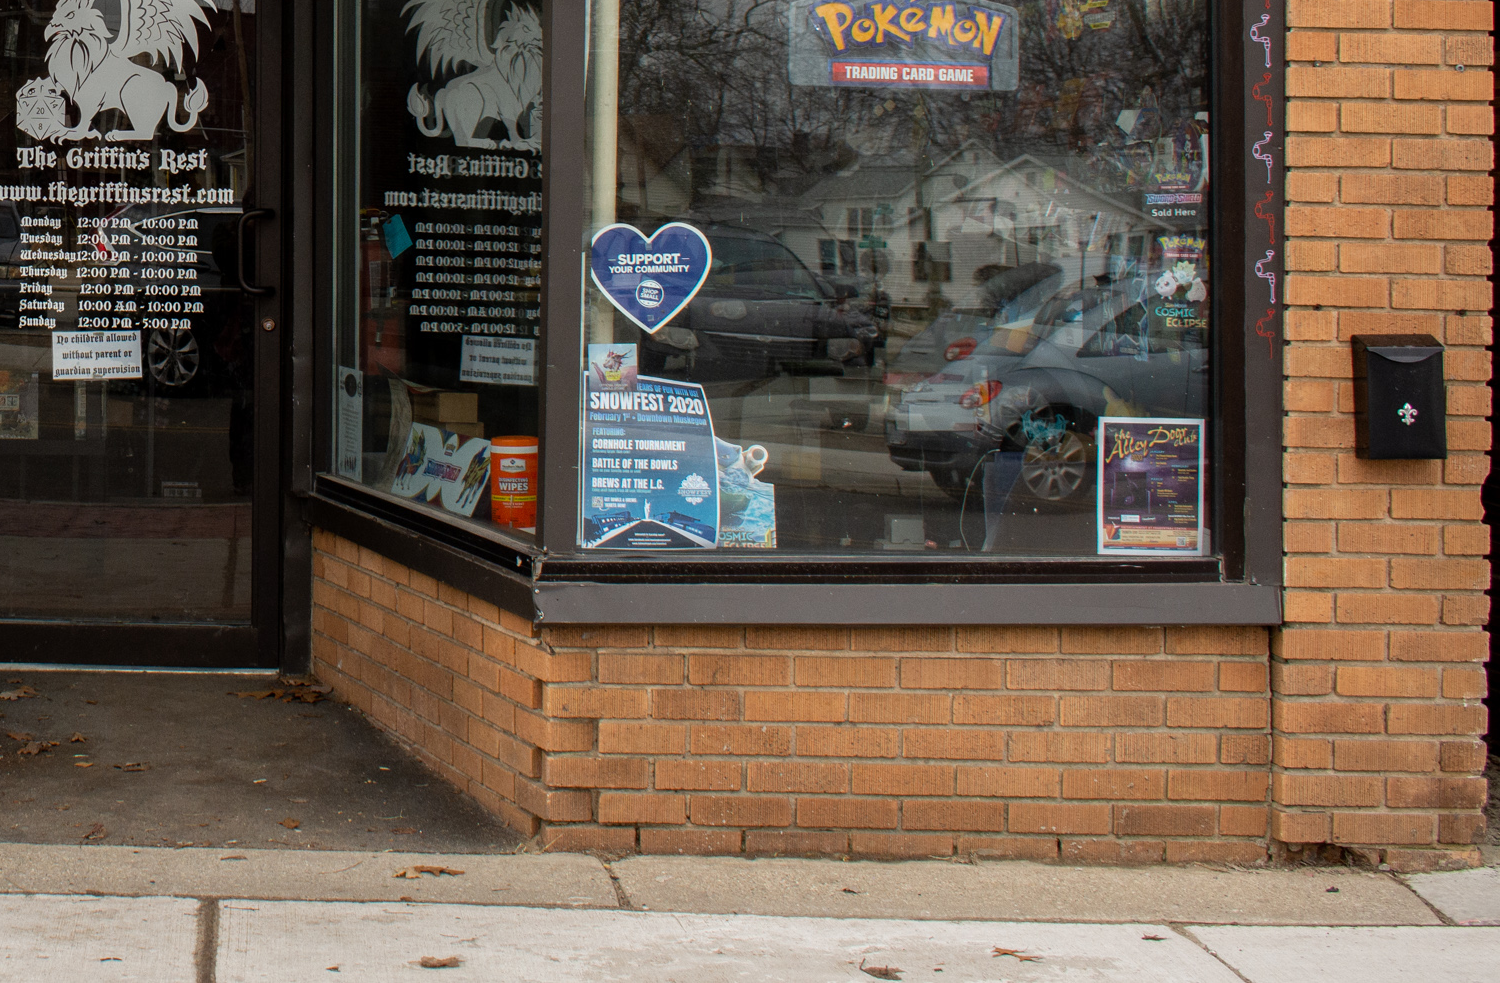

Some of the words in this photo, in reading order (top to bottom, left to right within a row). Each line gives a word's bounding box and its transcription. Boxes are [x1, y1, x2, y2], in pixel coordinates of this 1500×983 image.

[844, 65, 898, 82] TRADING
[901, 65, 936, 82] CARD
[938, 66, 974, 83] GAME
[16, 146, 57, 171] The
[66, 146, 150, 171] Griffin's
[158, 148, 208, 174] Rest
[1151, 208, 1172, 216] Sold
[20, 216, 62, 230] Monday
[77, 217, 108, 229] 12:00
[110, 218, 131, 230] PM
[142, 218, 175, 230] 10:00
[177, 218, 198, 230] PM
[20, 232, 62, 246] Tuesday
[77, 234, 108, 245] 12:00
[110, 234, 131, 246] PM
[141, 235, 175, 246] 10:00
[177, 235, 198, 246] PM
[20, 250, 76, 263] Wednesday
[77, 251, 108, 262] 12:00
[110, 251, 131, 262] PM
[141, 251, 175, 263] 10:00
[176, 252, 198, 263] PM
[617, 253, 680, 266] SUPPORT
[20, 266, 68, 280] Thursday
[76, 267, 108, 279] 12:00
[110, 267, 131, 279] PM
[141, 268, 174, 279] 10:00
[176, 268, 197, 279] PM
[608, 265, 633, 274] YOUR
[635, 264, 690, 273] COMMUNITY
[19, 283, 53, 296] Friday
[80, 284, 112, 295] 12:00
[113, 284, 134, 295] PM
[145, 285, 178, 296] 10:00
[180, 285, 201, 296] PM
[640, 293, 659, 301] SMALL
[19, 299, 65, 314] Saturday
[78, 301, 112, 312] 10:00
[114, 301, 137, 312] AM
[147, 301, 181, 313] 10:00
[183, 302, 204, 313] PM
[1155, 307, 1194, 317] COSMIC
[19, 316, 56, 330] Sunday
[78, 317, 109, 329] 12:00
[112, 317, 132, 329] PM
[142, 318, 168, 329] 5:00
[171, 319, 191, 330] PM
[1166, 318, 1207, 327] ECLIPSE
[56, 335, 69, 346] No
[71, 333, 104, 345] children
[106, 332, 137, 343] allowed
[62, 349, 94, 361] without
[95, 349, 122, 361] parent
[124, 350, 132, 359] or
[54, 366, 91, 378] guardian
[93, 364, 141, 376] supervision
[674, 388, 688, 396] WITH
[590, 392, 664, 412] SNOWFEST
[668, 396, 704, 415] 2020
[590, 412, 621, 422] February
[637, 413, 672, 423] Downtown
[673, 415, 707, 426] Muskegon
[592, 428, 626, 436] FEATURING:
[1114, 429, 1131, 442] the
[592, 439, 633, 450] CORNHOLE
[635, 440, 686, 451] TOURNAMENT
[1105, 437, 1149, 463] Alley
[1148, 426, 1188, 447] Door
[592, 458, 620, 468] BATTLE
[622, 459, 632, 469] OF
[634, 460, 648, 469] THE
[650, 460, 678, 470] BOWLS
[499, 483, 528, 491] WIPES
[592, 478, 619, 488] BREWS
[621, 479, 631, 489] AT
[634, 479, 648, 489] THE
[719, 532, 754, 541] OSMIC
